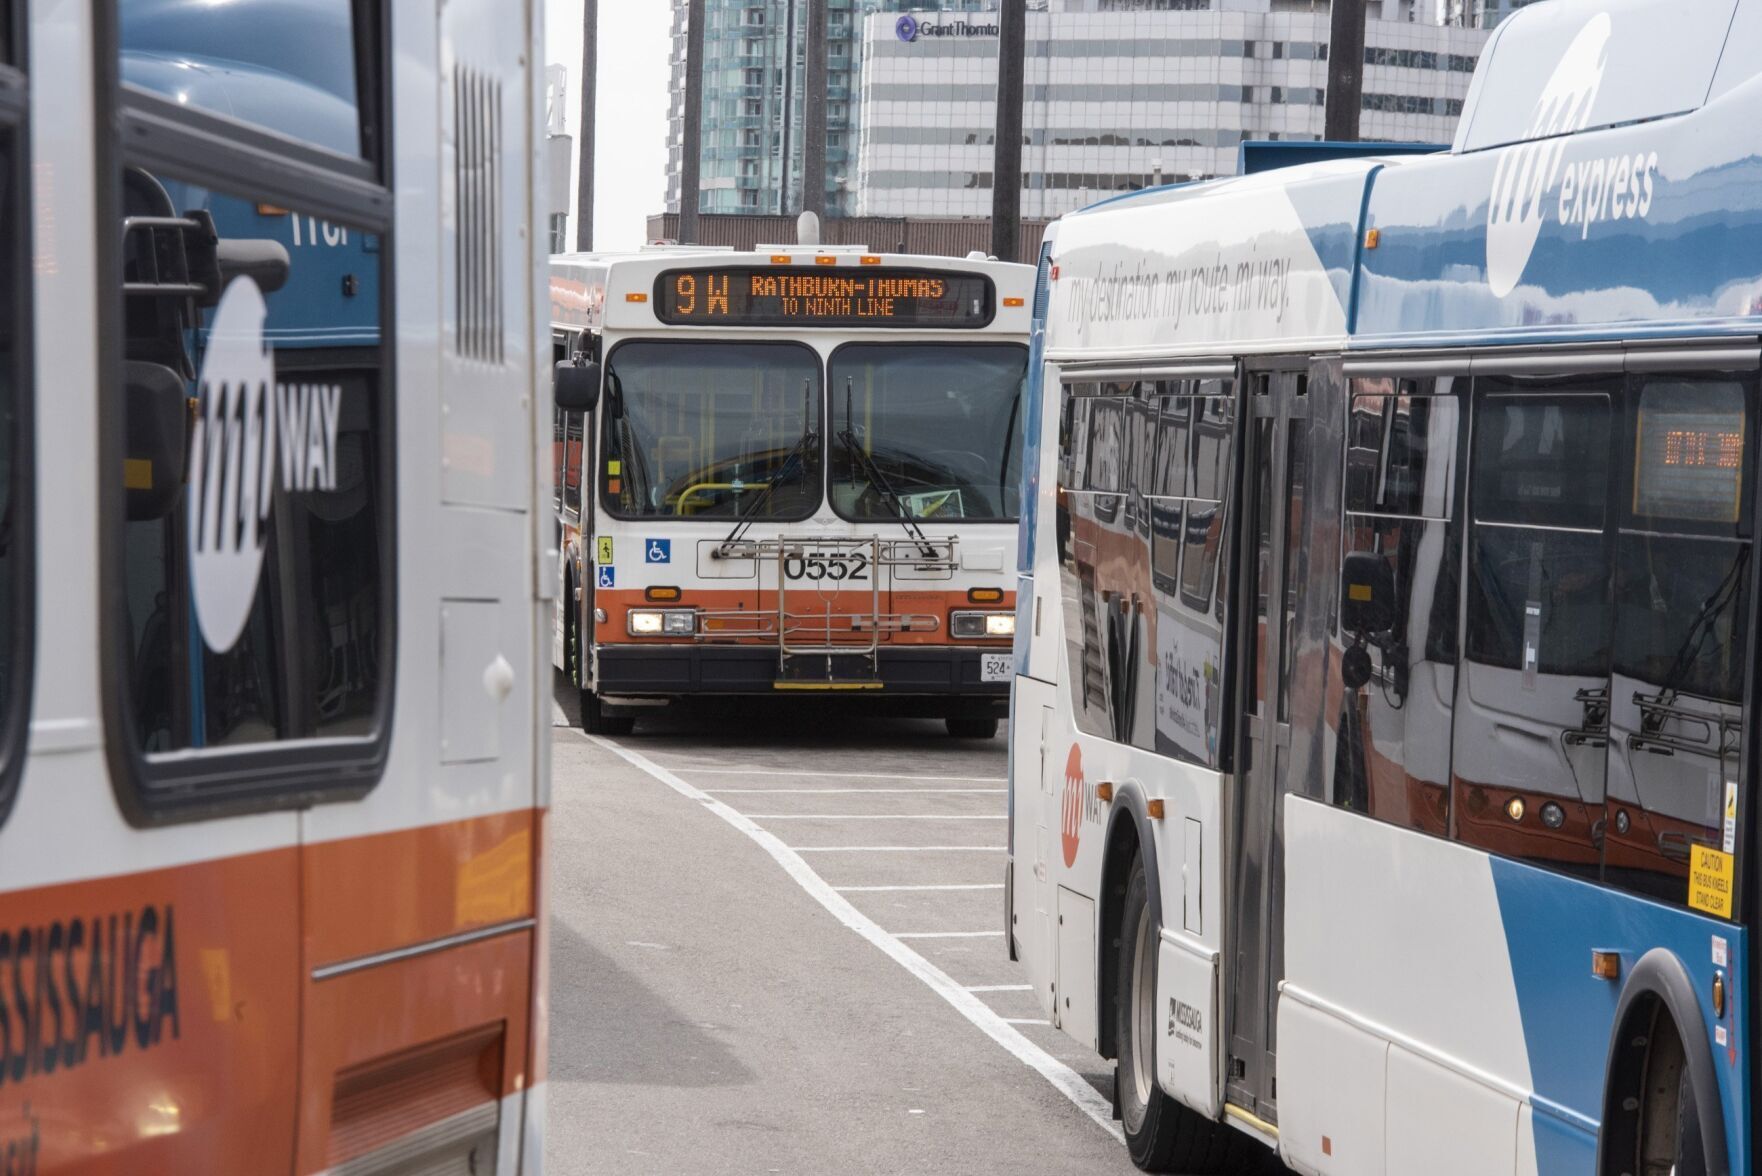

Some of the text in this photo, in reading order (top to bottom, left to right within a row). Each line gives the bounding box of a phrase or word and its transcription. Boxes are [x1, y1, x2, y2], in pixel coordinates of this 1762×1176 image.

[920, 21, 954, 37] Grant
[1558, 151, 1658, 241] express
[677, 275, 728, 314] 9 W
[1068, 278, 1088, 335] my
[1163, 268, 1187, 331] my
[1233, 242, 1257, 312] mi
[1257, 257, 1291, 324] way.
[782, 297, 894, 316] TO NINTH LINE
[277, 382, 341, 492] WAY
[783, 552, 868, 580] 0552
[1700, 851, 1723, 873] CAUTION
